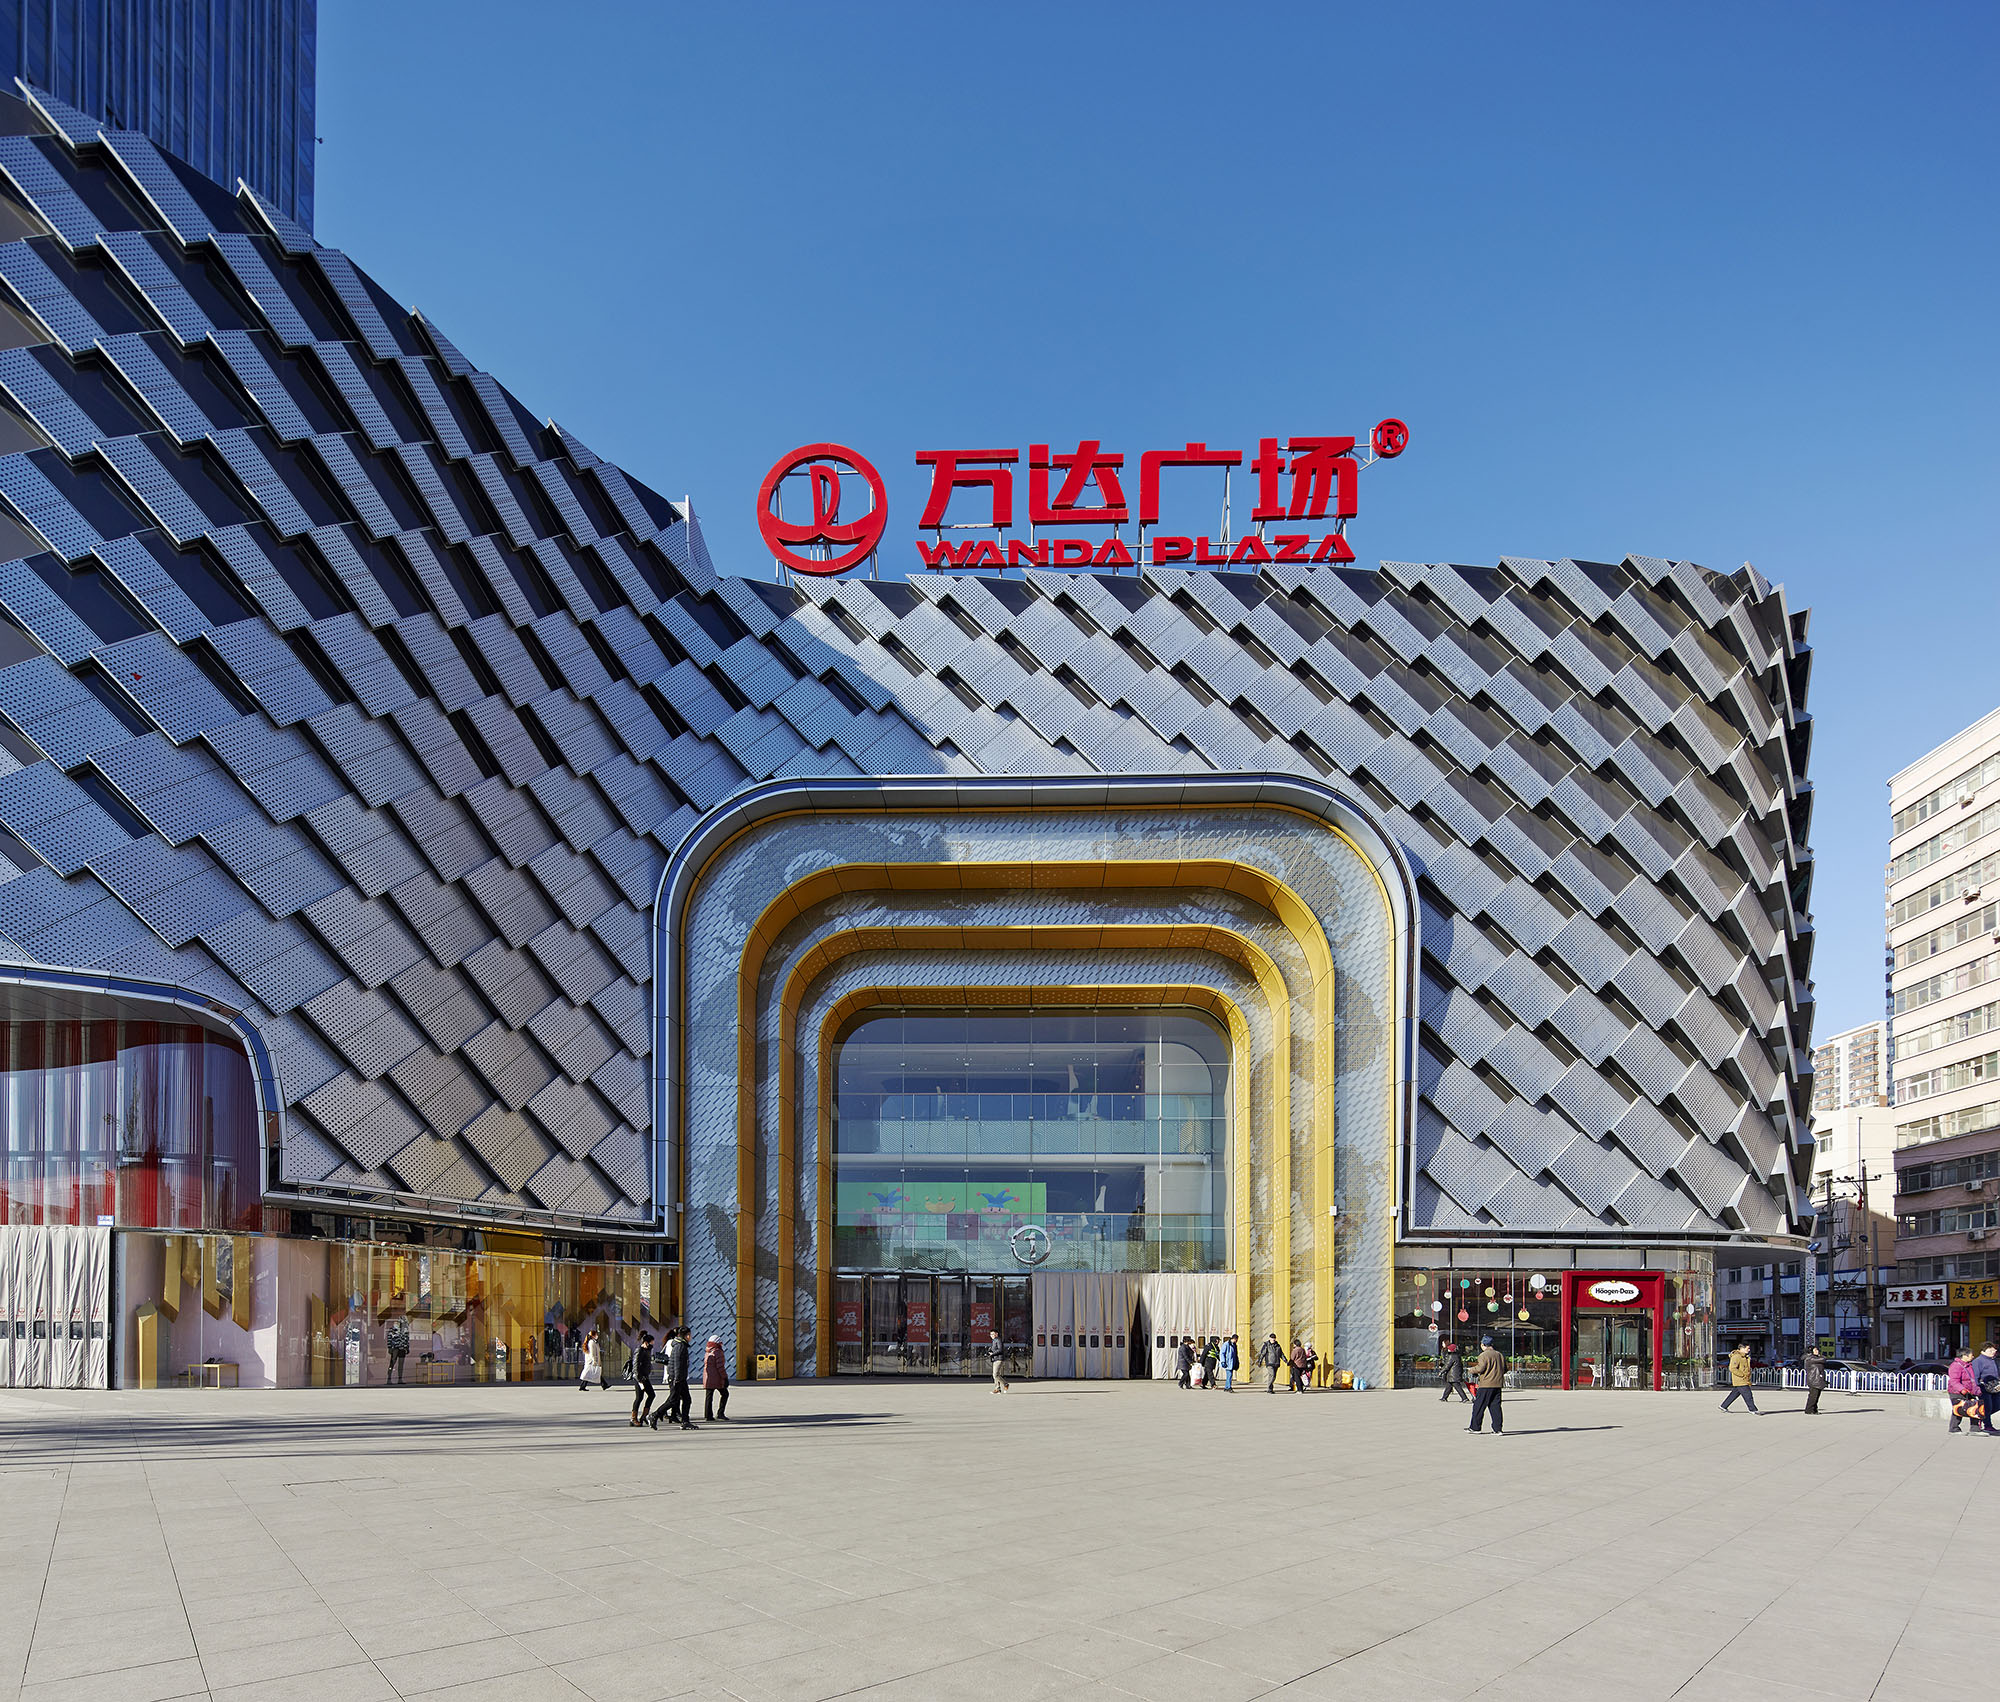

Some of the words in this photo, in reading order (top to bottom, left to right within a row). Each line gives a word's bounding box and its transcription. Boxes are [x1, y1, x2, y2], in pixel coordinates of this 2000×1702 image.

[915, 436, 1358, 530] 万达广场
[915, 538, 1135, 569] WANDA
[1152, 534, 1356, 566] PLAZA
[1952, 1285, 1994, 1299] 皮艺轩
